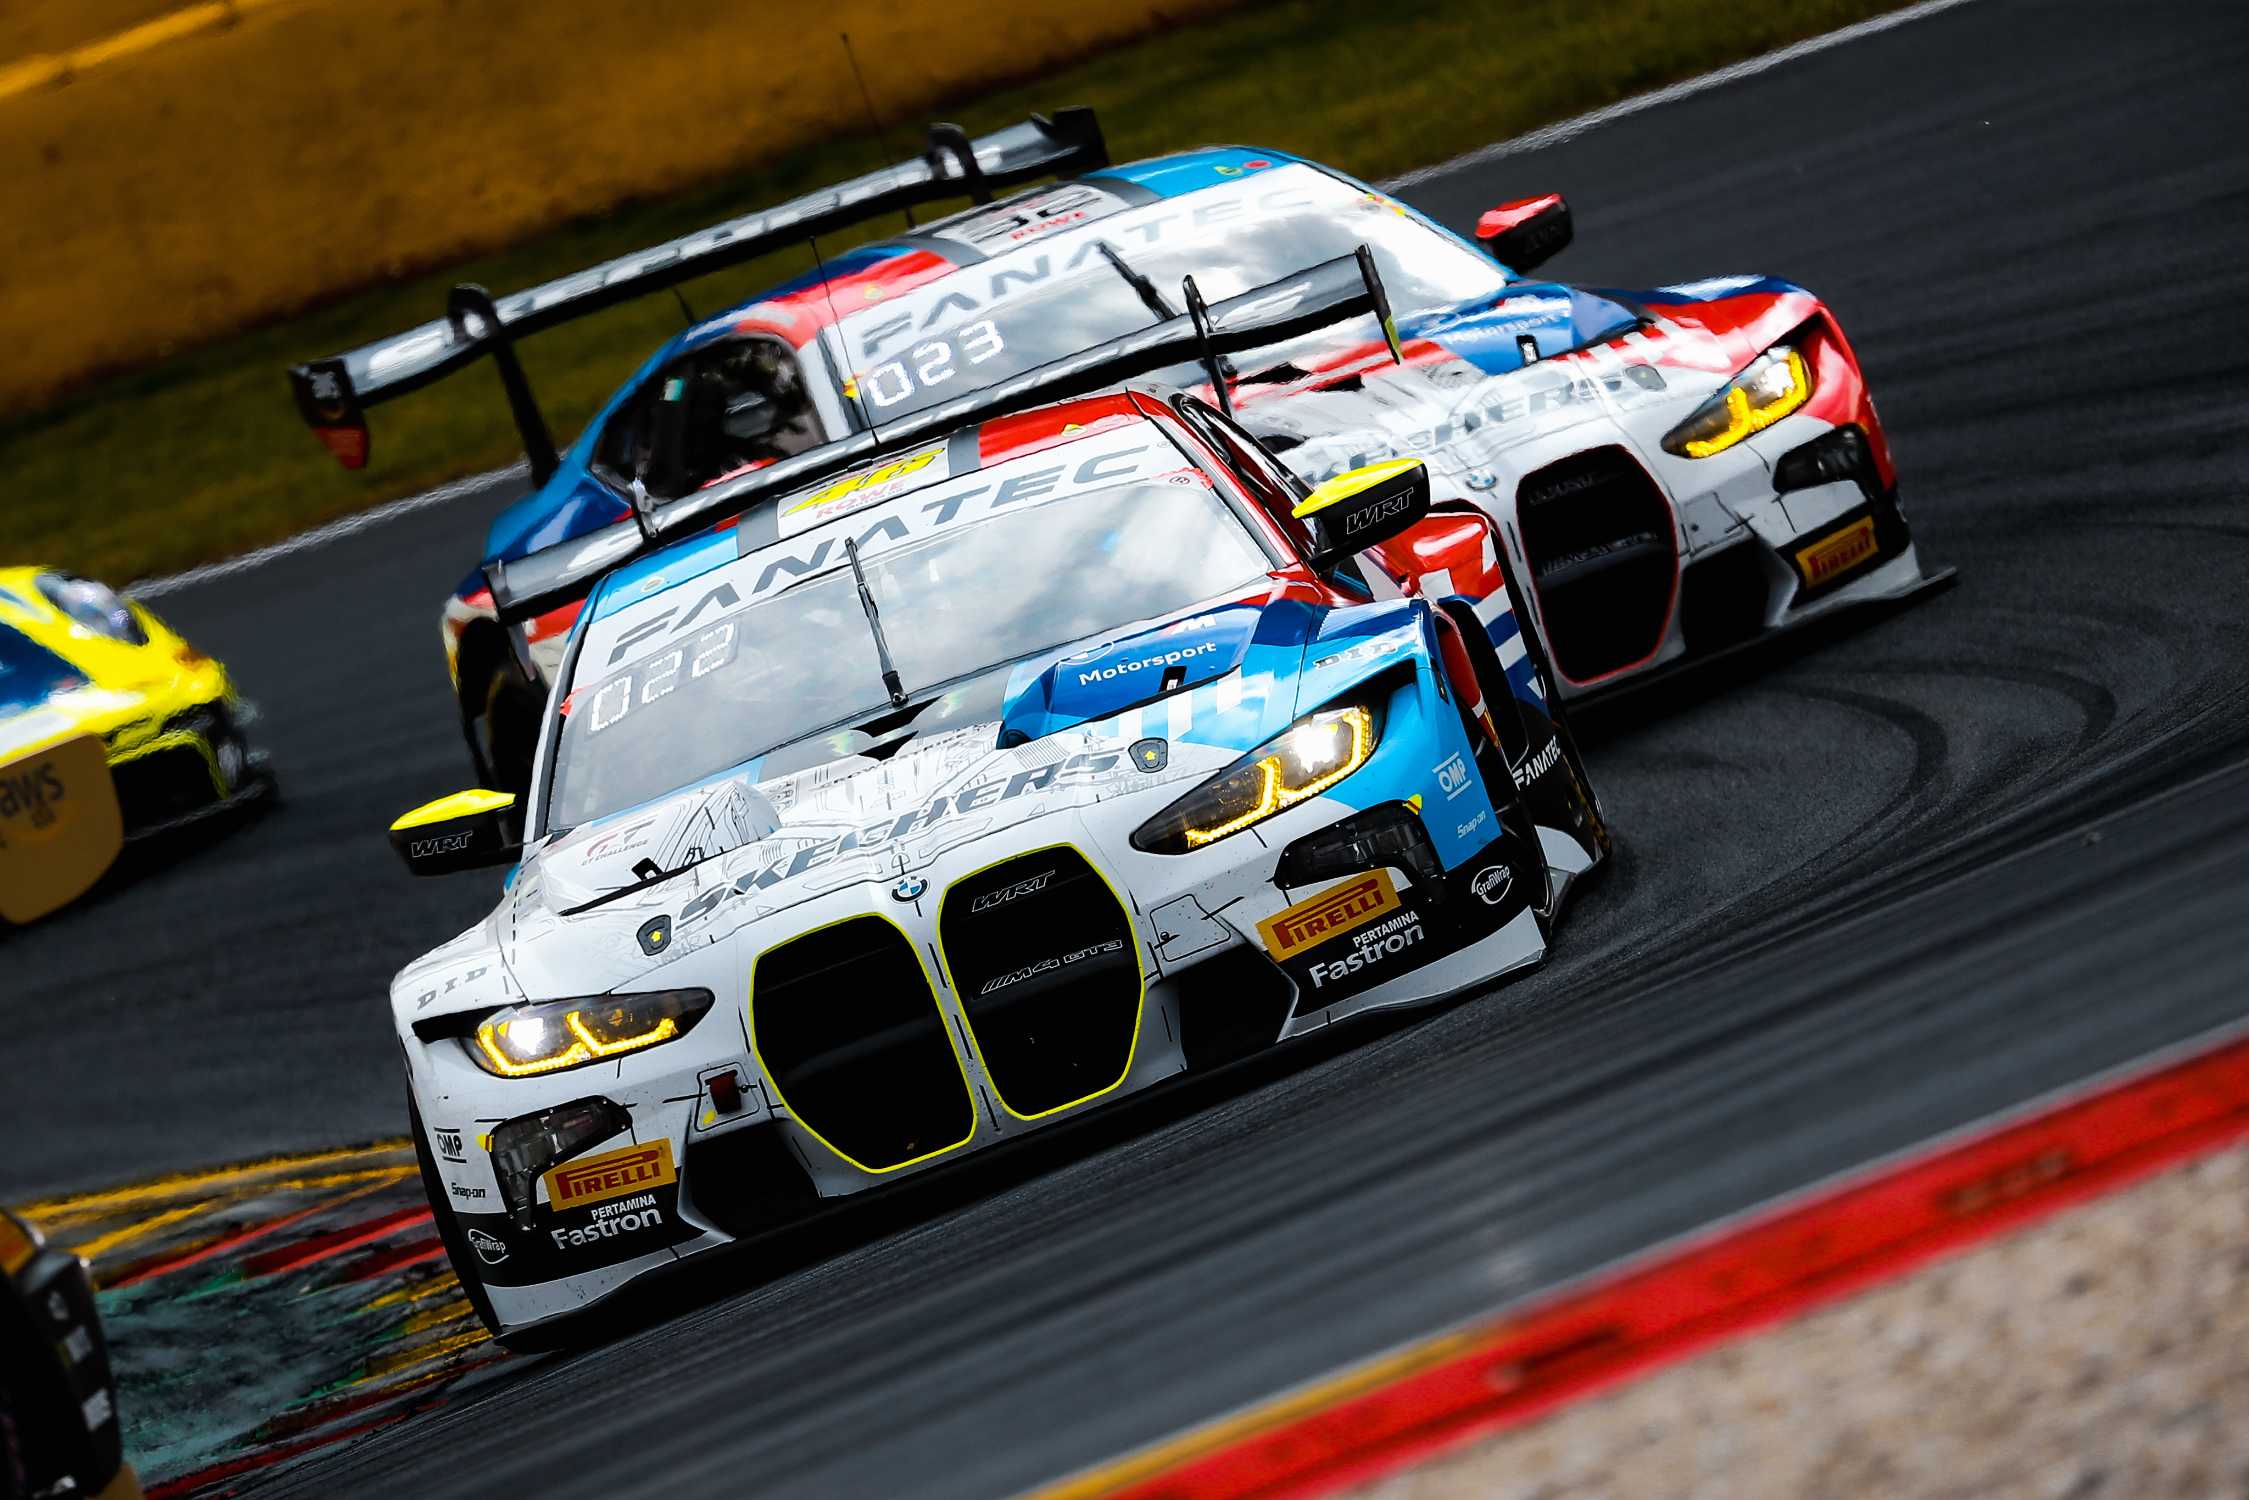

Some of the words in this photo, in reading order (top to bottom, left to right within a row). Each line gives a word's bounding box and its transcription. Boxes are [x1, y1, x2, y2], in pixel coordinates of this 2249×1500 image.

[861, 187, 1317, 358] FANATEC
[866, 319, 1006, 408] 023
[816, 480, 905, 518] ROWE
[1346, 487, 1414, 535] WRT
[607, 445, 1148, 668] FANATEC
[590, 622, 737, 733] 022
[1078, 640, 1217, 687] Motorsport
[1438, 758, 1467, 792] OMP
[1512, 735, 1561, 791] FANATEC
[411, 831, 473, 858] WRT
[676, 749, 1124, 930] SKECHERS
[972, 869, 1056, 913] WRT
[1271, 878, 1385, 950] PIRELLI
[1063, 939, 1123, 963] GT3
[1352, 910, 1419, 948] PERTAMINA
[1308, 924, 1425, 989] Fastron
[437, 1134, 463, 1157] OMP
[555, 1150, 661, 1200] PIRELLI
[551, 1207, 662, 1250] Fastron
[591, 1194, 657, 1221] PERTAMINA
